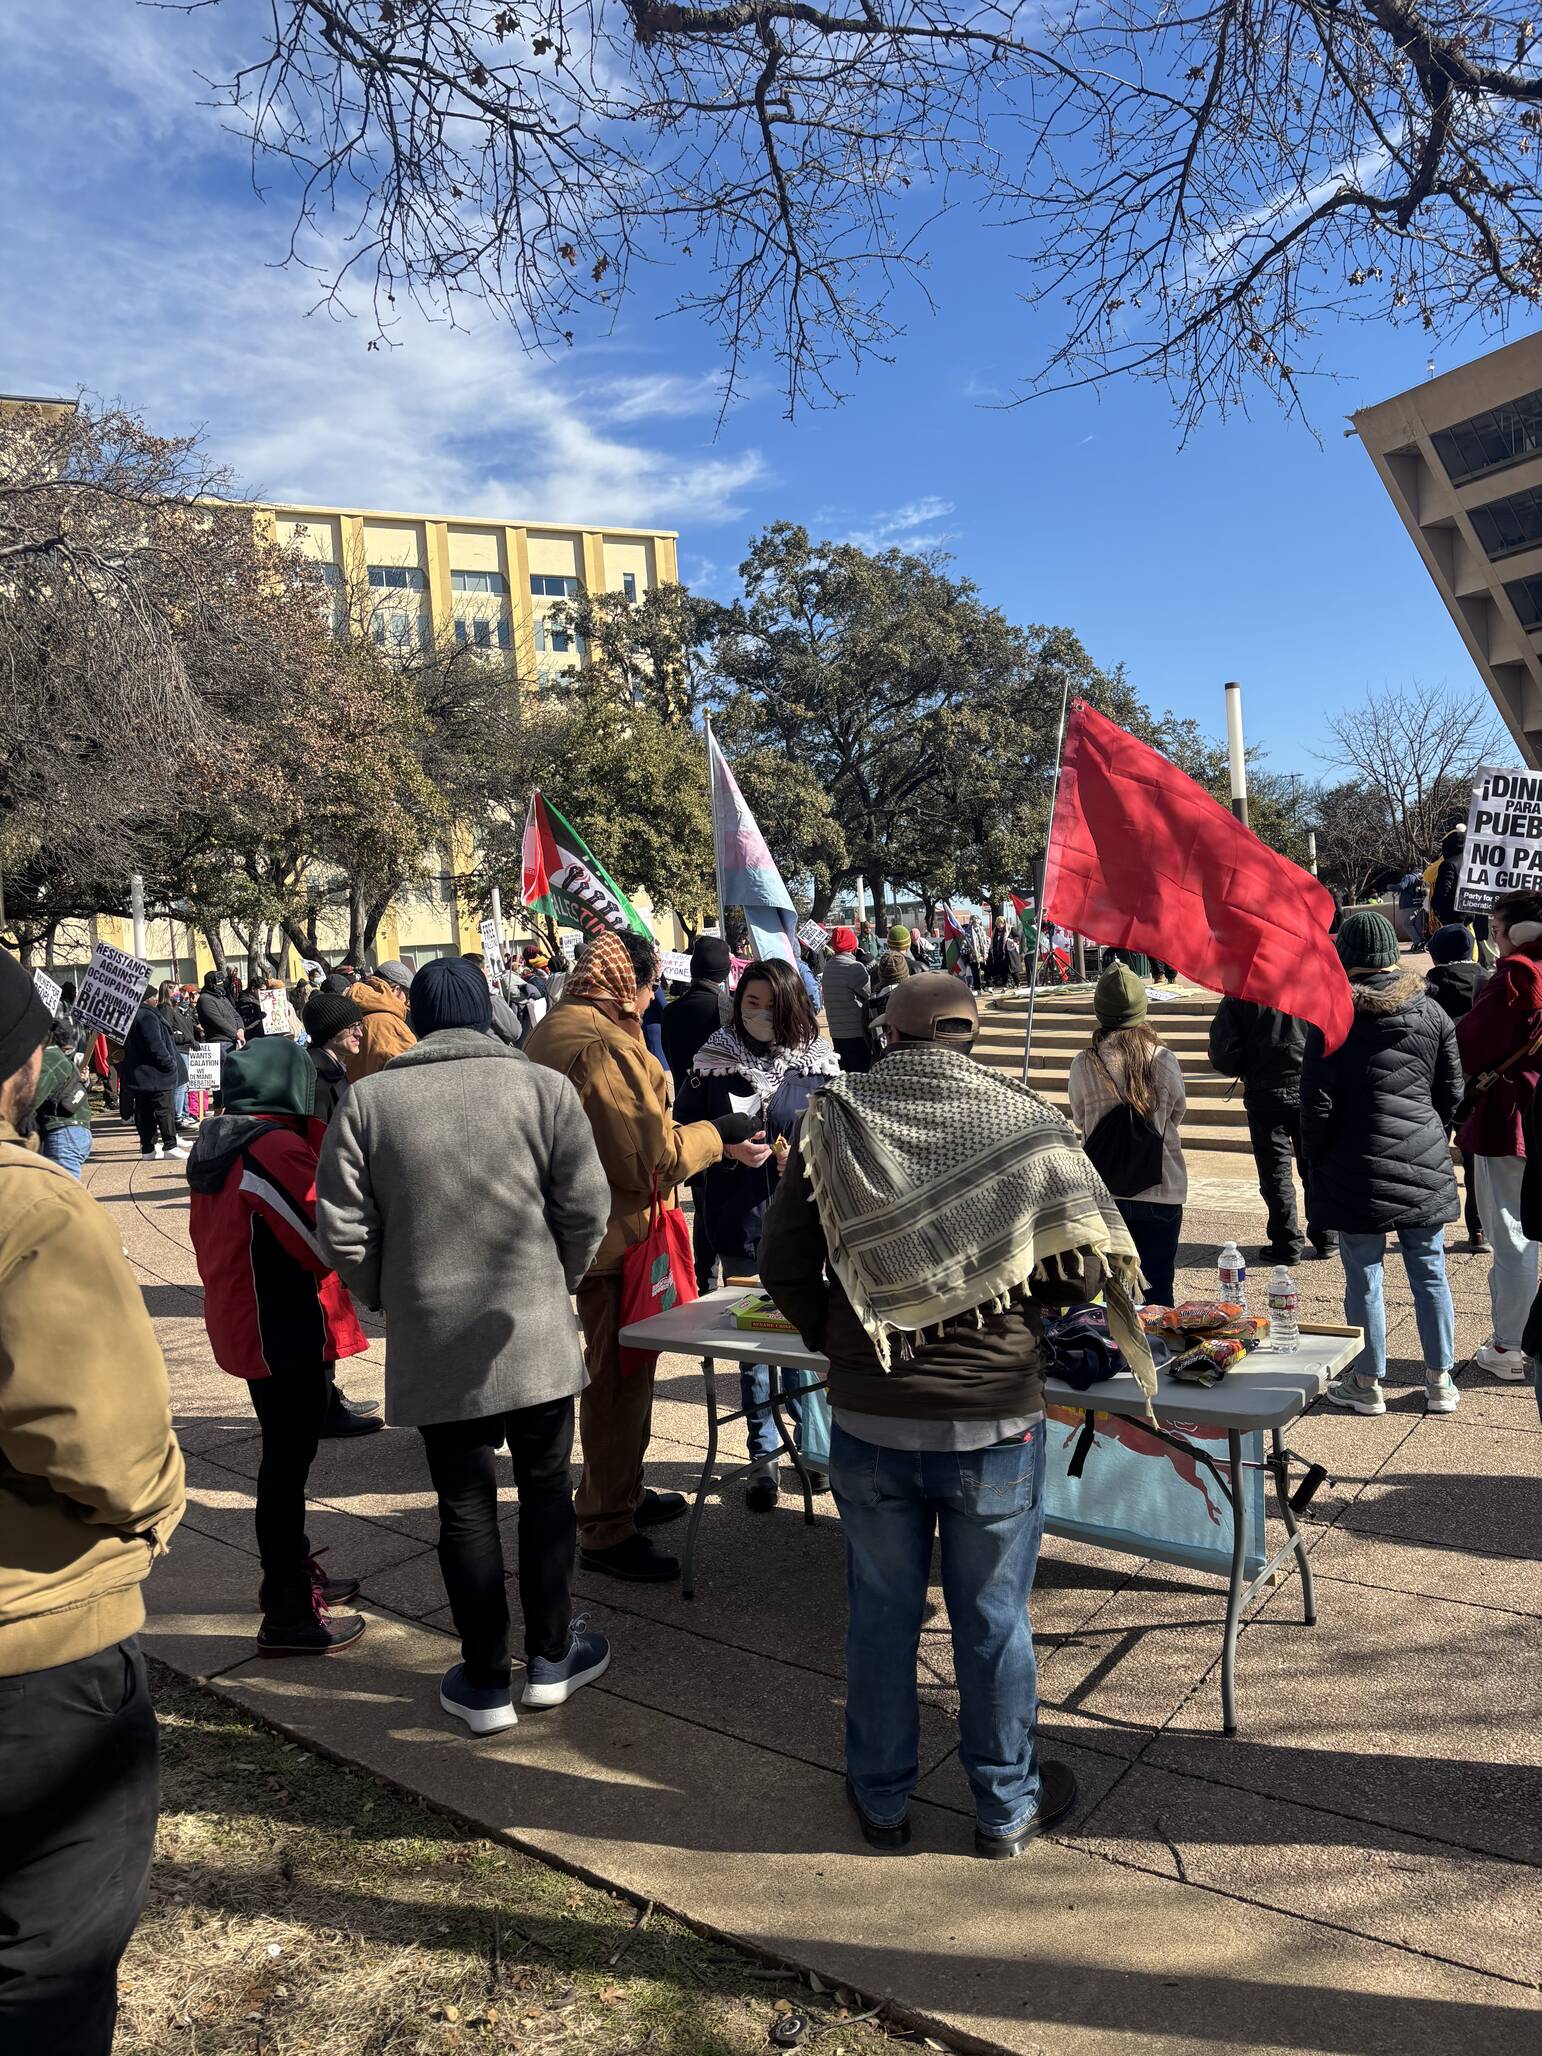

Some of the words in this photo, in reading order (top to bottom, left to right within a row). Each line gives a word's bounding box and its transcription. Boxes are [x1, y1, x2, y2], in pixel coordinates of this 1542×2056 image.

[1505, 800, 1542, 815] PARA
[1474, 810, 1542, 839] PUEB
[1470, 843, 1506, 867] NO
[1466, 867, 1489, 886] LA
[1463, 891, 1482, 902] Party
[1483, 894, 1493, 902] for
[96, 943, 152, 979] RESISTANCE
[100, 959, 139, 987] AGAINST
[83, 981, 93, 993] IS
[94, 987, 101, 998] A
[102, 990, 135, 1015] HUMAN
[88, 966, 142, 1002] OCCUPATION
[76, 990, 131, 1032] RIGHT!
